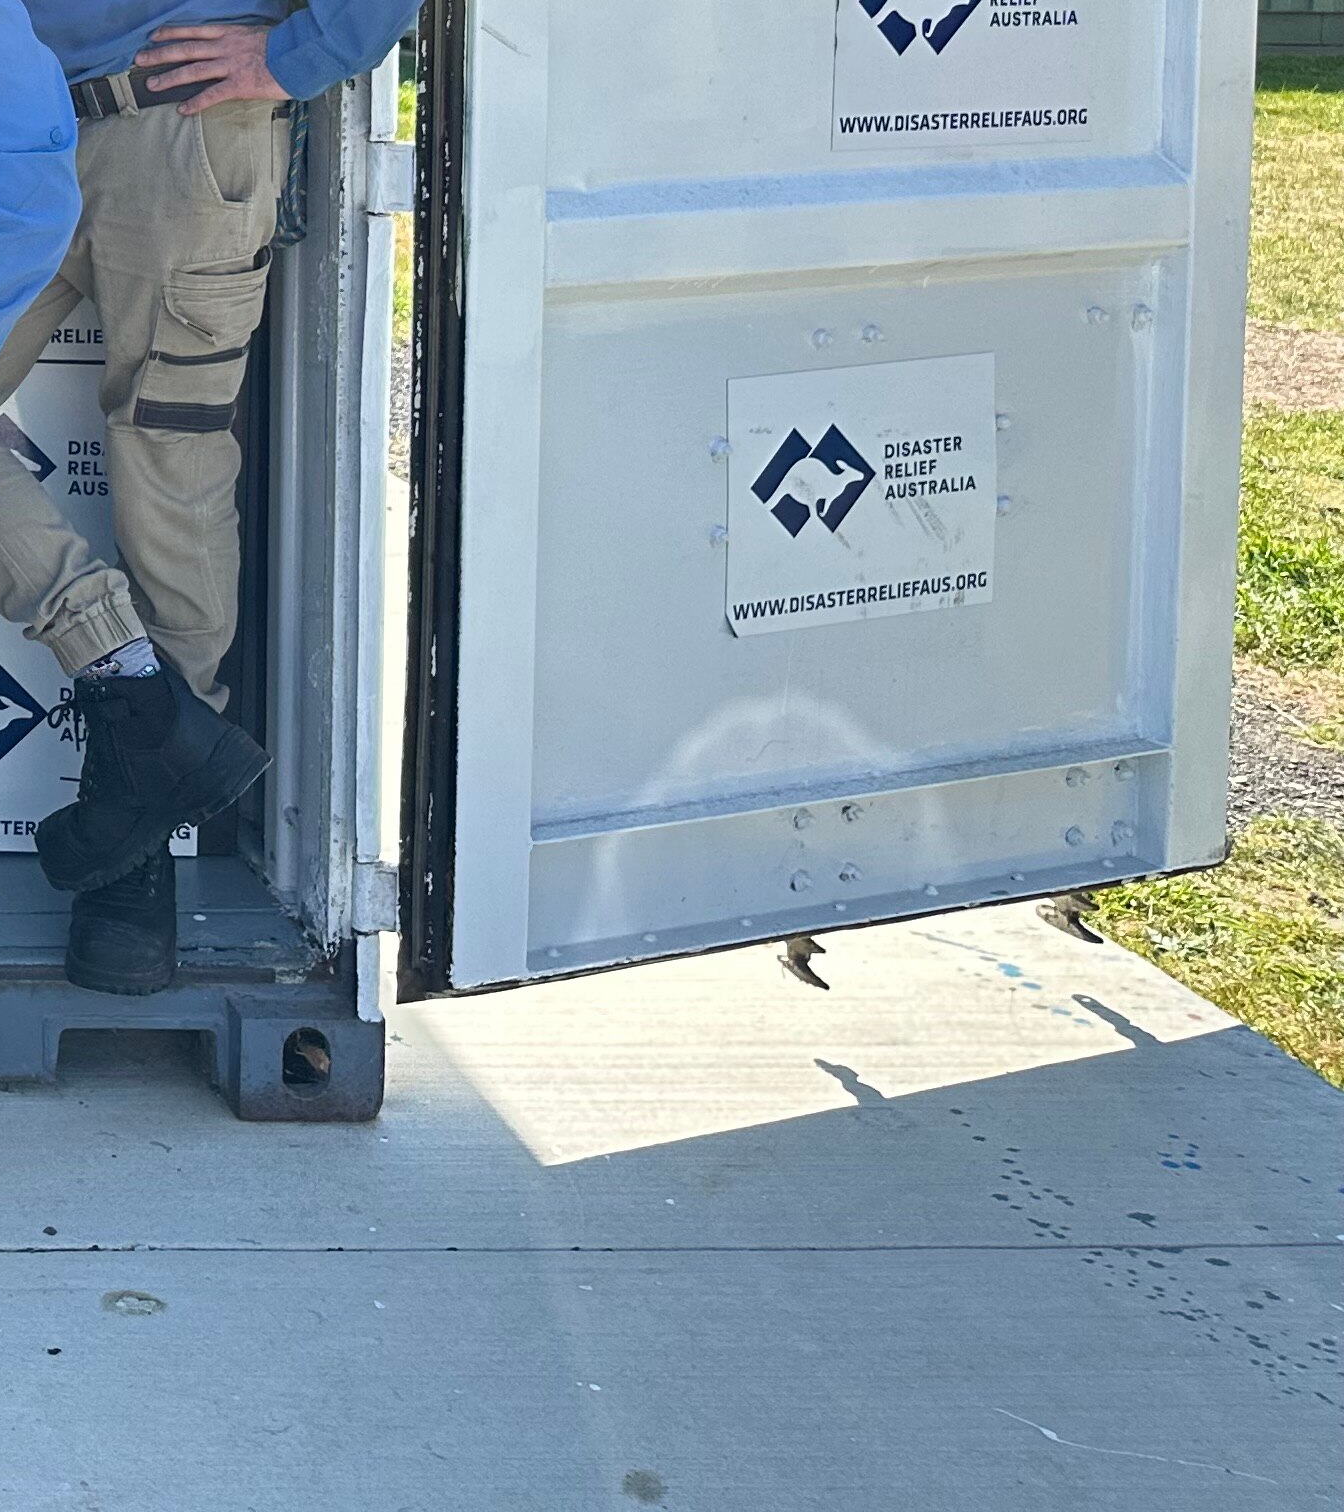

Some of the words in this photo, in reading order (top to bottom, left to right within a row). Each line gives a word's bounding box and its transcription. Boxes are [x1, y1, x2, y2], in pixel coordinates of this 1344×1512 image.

[990, 10, 1079, 29] AUSTRALIA
[840, 108, 1089, 135] WWW.DISASTERRELIEFAUS.ORG
[50, 328, 104, 344] RELIE
[884, 436, 963, 460] DISASTER
[884, 460, 938, 480] RELIEF
[885, 475, 977, 501] AUSTRALIA
[733, 570, 988, 622] WWW.DISASTERRELIEFAUS.ORG
